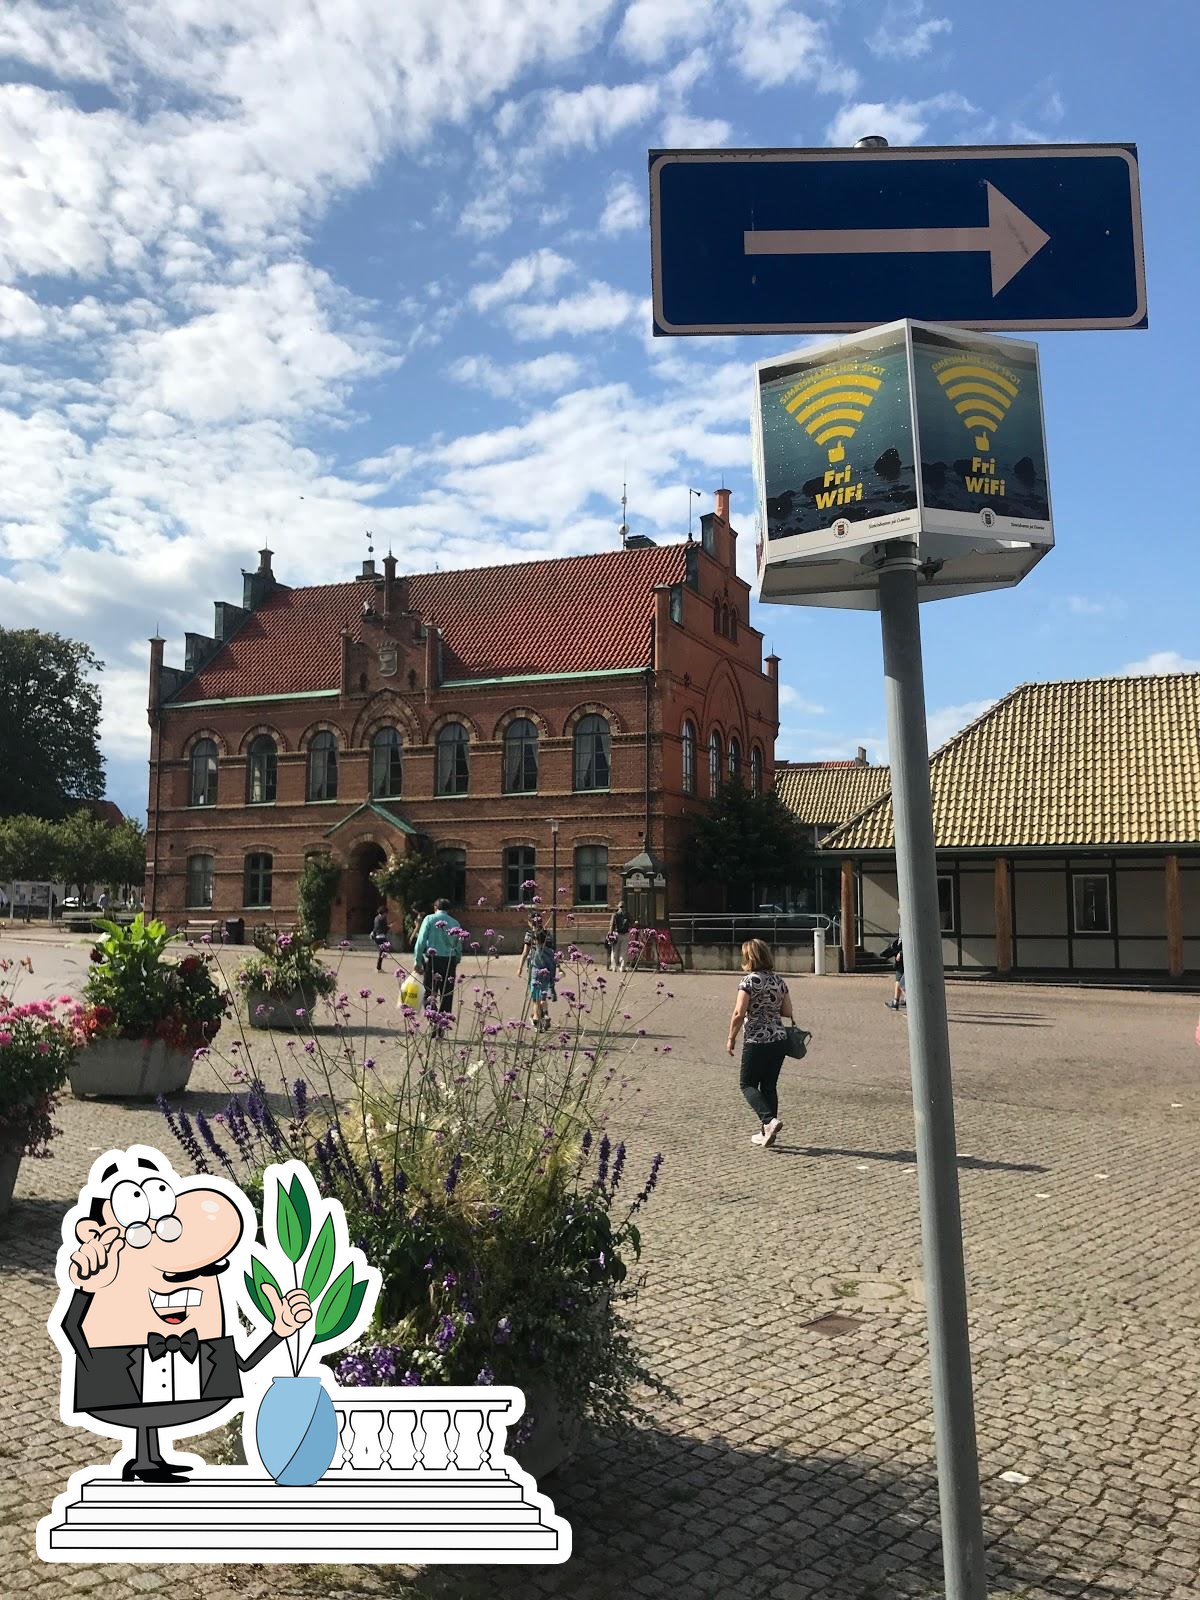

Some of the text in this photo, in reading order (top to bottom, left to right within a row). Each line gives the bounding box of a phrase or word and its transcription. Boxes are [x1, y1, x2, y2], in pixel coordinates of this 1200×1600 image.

[862, 363, 886, 375] SPOT
[823, 464, 851, 487] Fri
[972, 456, 996, 474] Fri
[815, 482, 863, 509] WiFi
[964, 475, 1006, 496] WiFi
